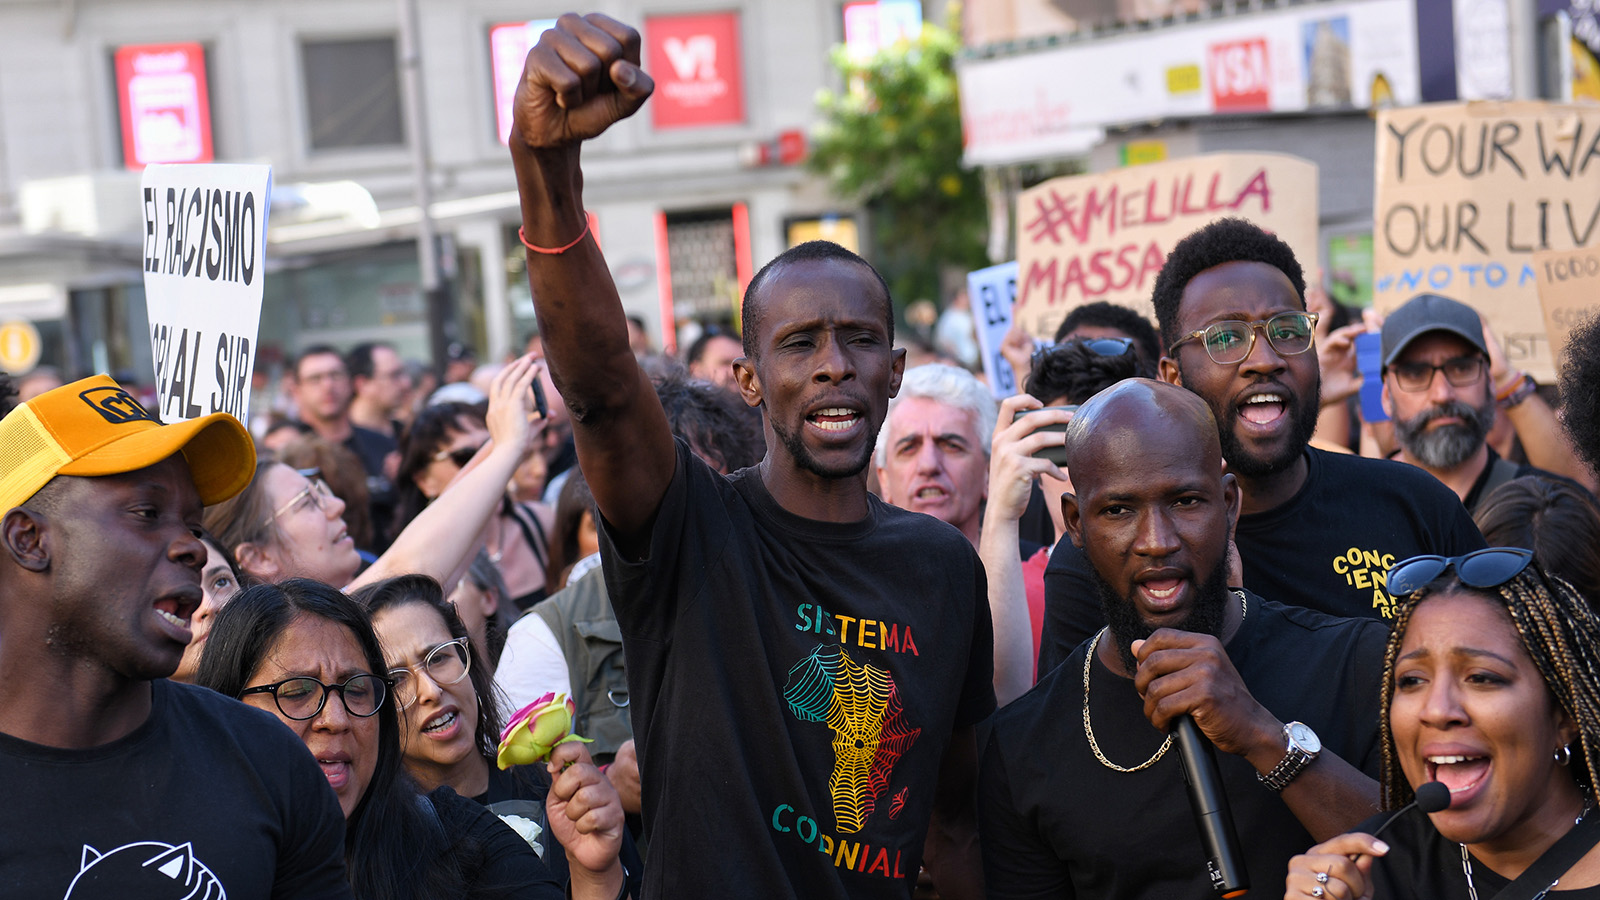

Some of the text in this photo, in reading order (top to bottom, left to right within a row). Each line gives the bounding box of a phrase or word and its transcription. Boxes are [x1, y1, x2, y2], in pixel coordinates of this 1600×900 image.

[1387, 117, 1526, 182] YOUR
[144, 187, 255, 286] EL RACISMO
[1384, 200, 1600, 258] OUR LIV
[977, 283, 1008, 327] EL
